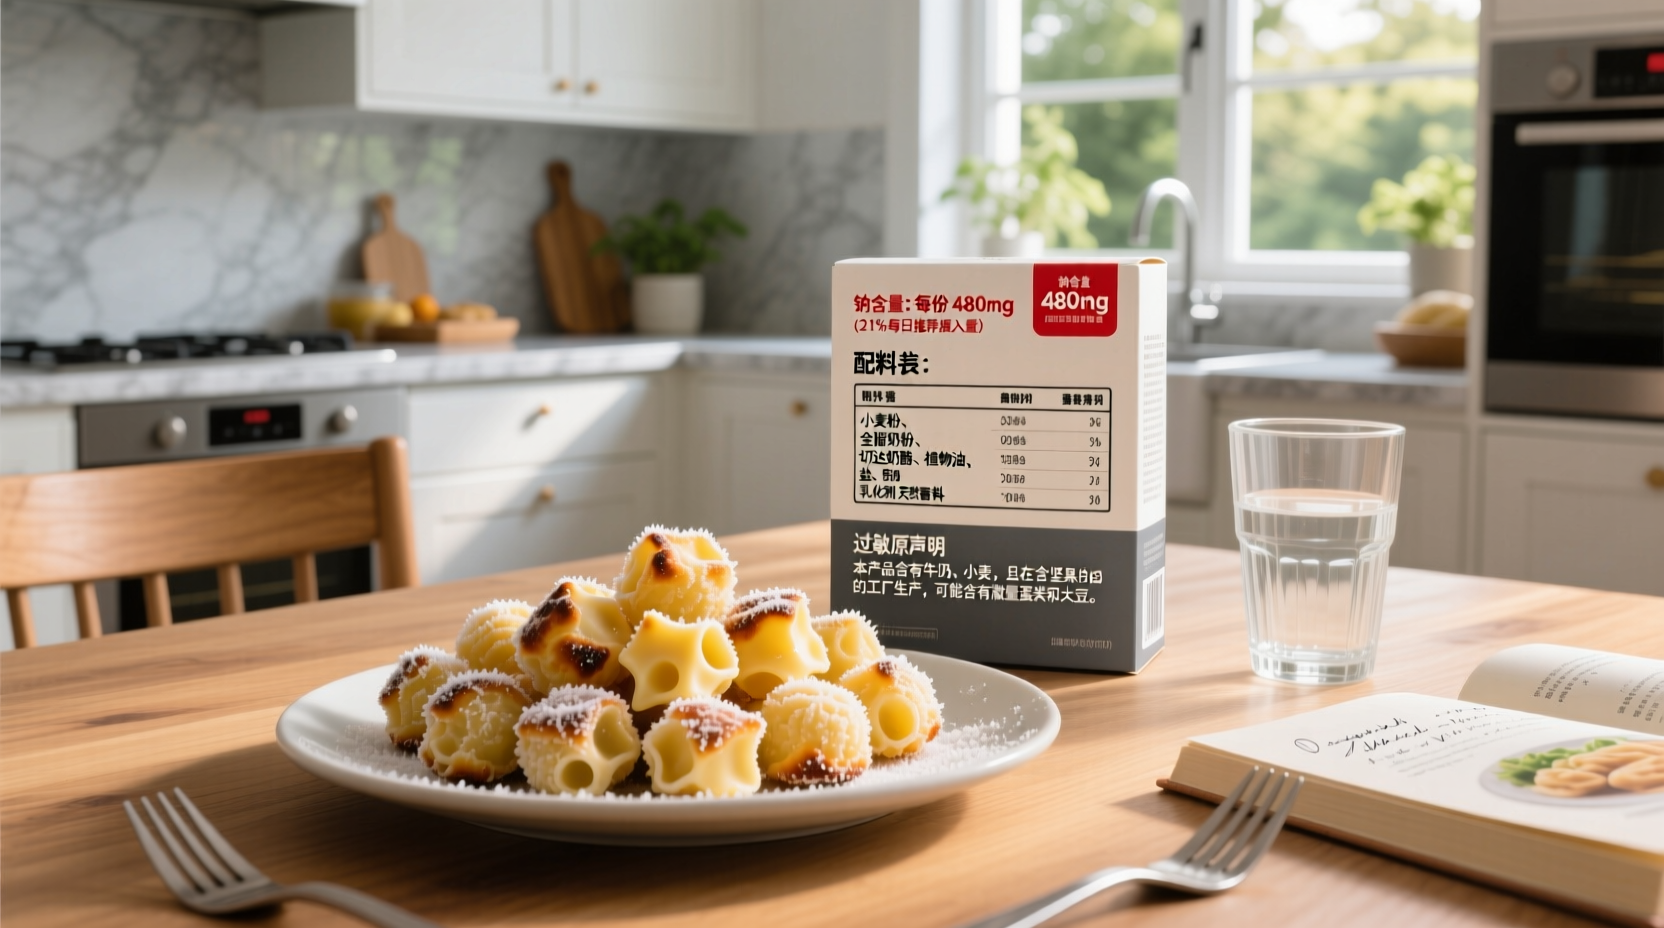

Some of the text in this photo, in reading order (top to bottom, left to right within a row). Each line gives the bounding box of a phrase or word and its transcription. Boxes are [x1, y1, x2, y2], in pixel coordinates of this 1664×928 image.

[952, 295, 1014, 318] 480mg
[853, 532, 946, 557] 过敏原声明
